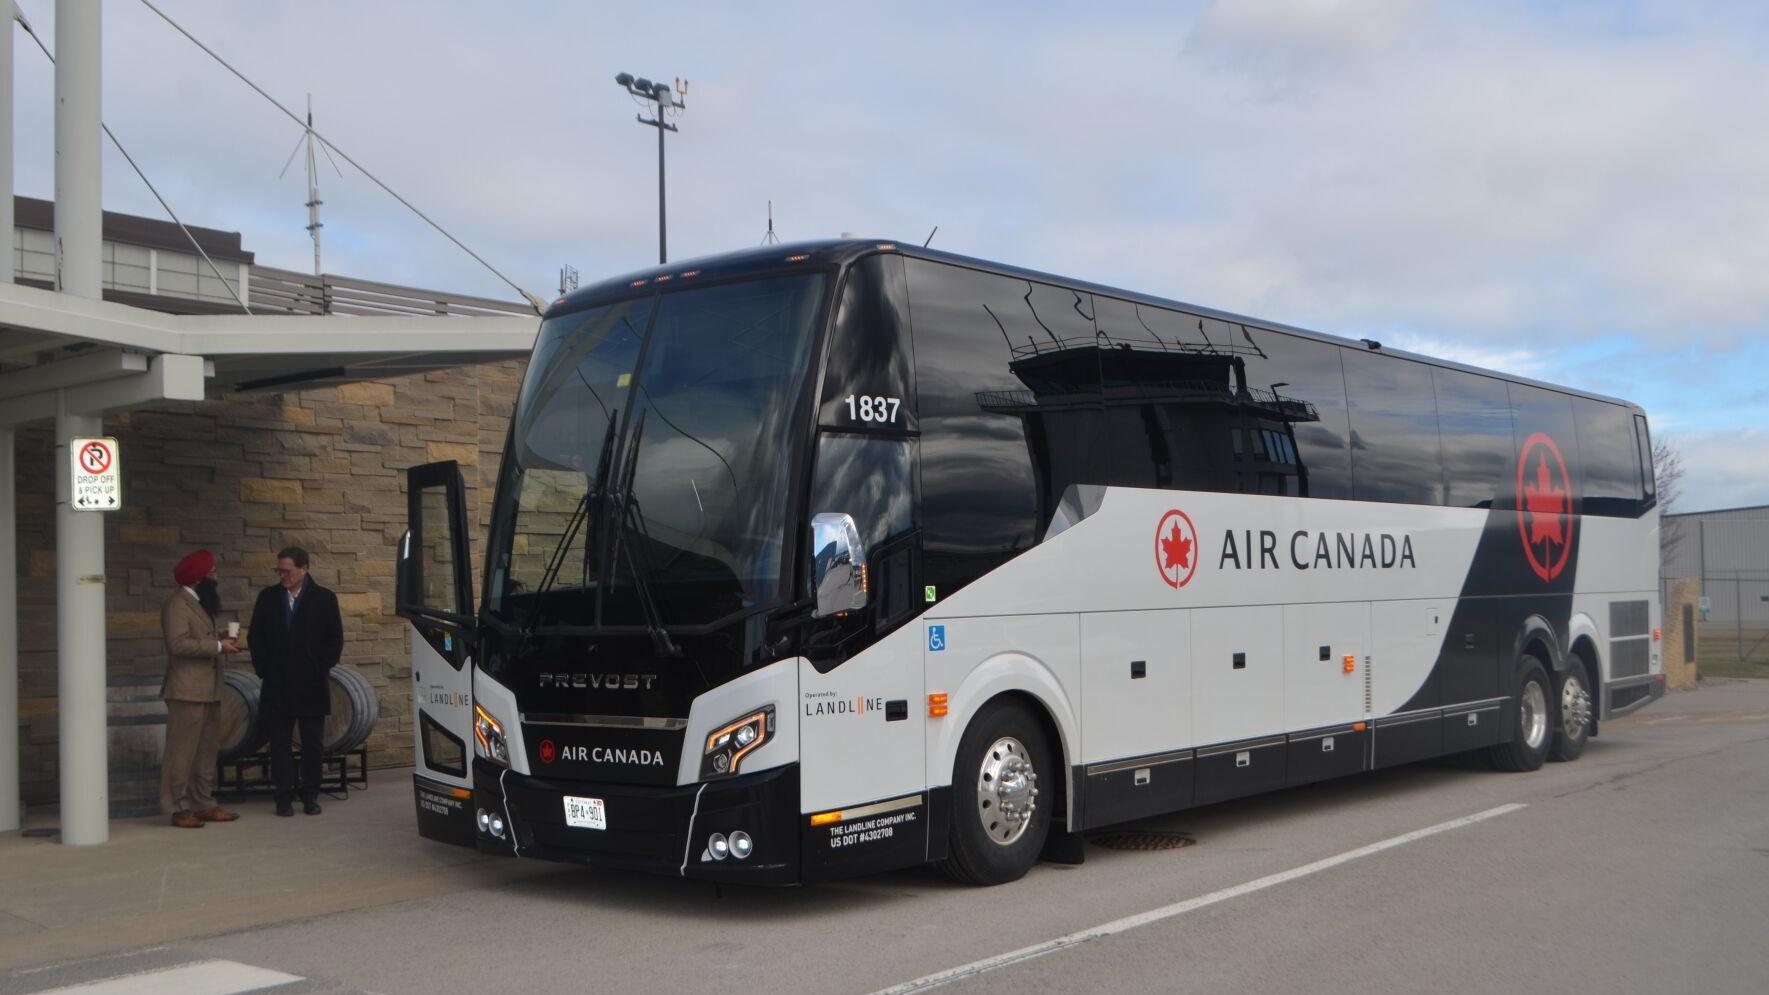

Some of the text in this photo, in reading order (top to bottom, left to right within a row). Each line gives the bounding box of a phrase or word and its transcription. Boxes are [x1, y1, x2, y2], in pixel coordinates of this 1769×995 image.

[845, 394, 900, 423] 1837
[77, 475, 115, 484] DROP OFF
[85, 485, 103, 495] PICK
[105, 485, 115, 495] UP
[1219, 529, 1416, 570] AIR CANADA
[539, 672, 657, 689] PREVOST
[561, 746, 664, 766] AIR CANADA
[830, 811, 917, 837] THE LANDLINE COMPANY INC.
[830, 827, 893, 848] US DOT #4302708
